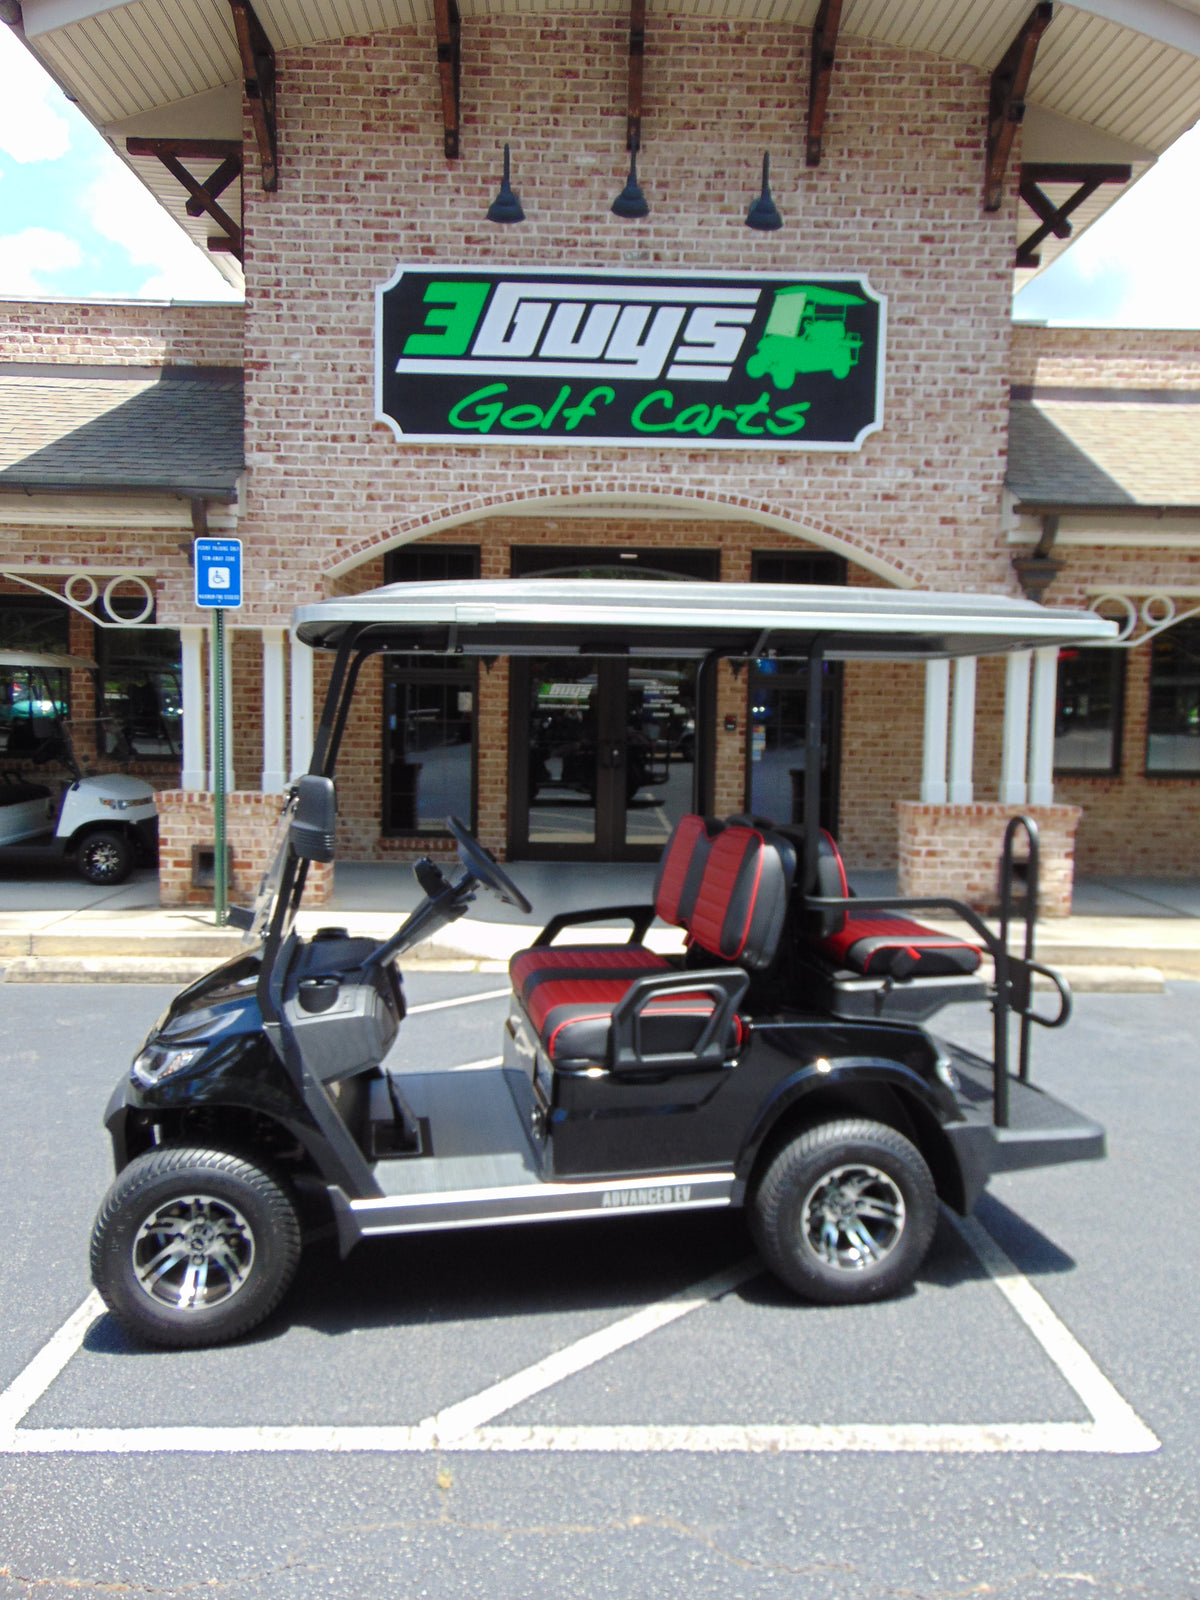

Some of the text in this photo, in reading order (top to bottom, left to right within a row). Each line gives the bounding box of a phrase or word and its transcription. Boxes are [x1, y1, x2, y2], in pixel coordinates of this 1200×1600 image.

[447, 382, 811, 436] Golf Carts
[602, 1185, 691, 1208] ADVANCED EV
